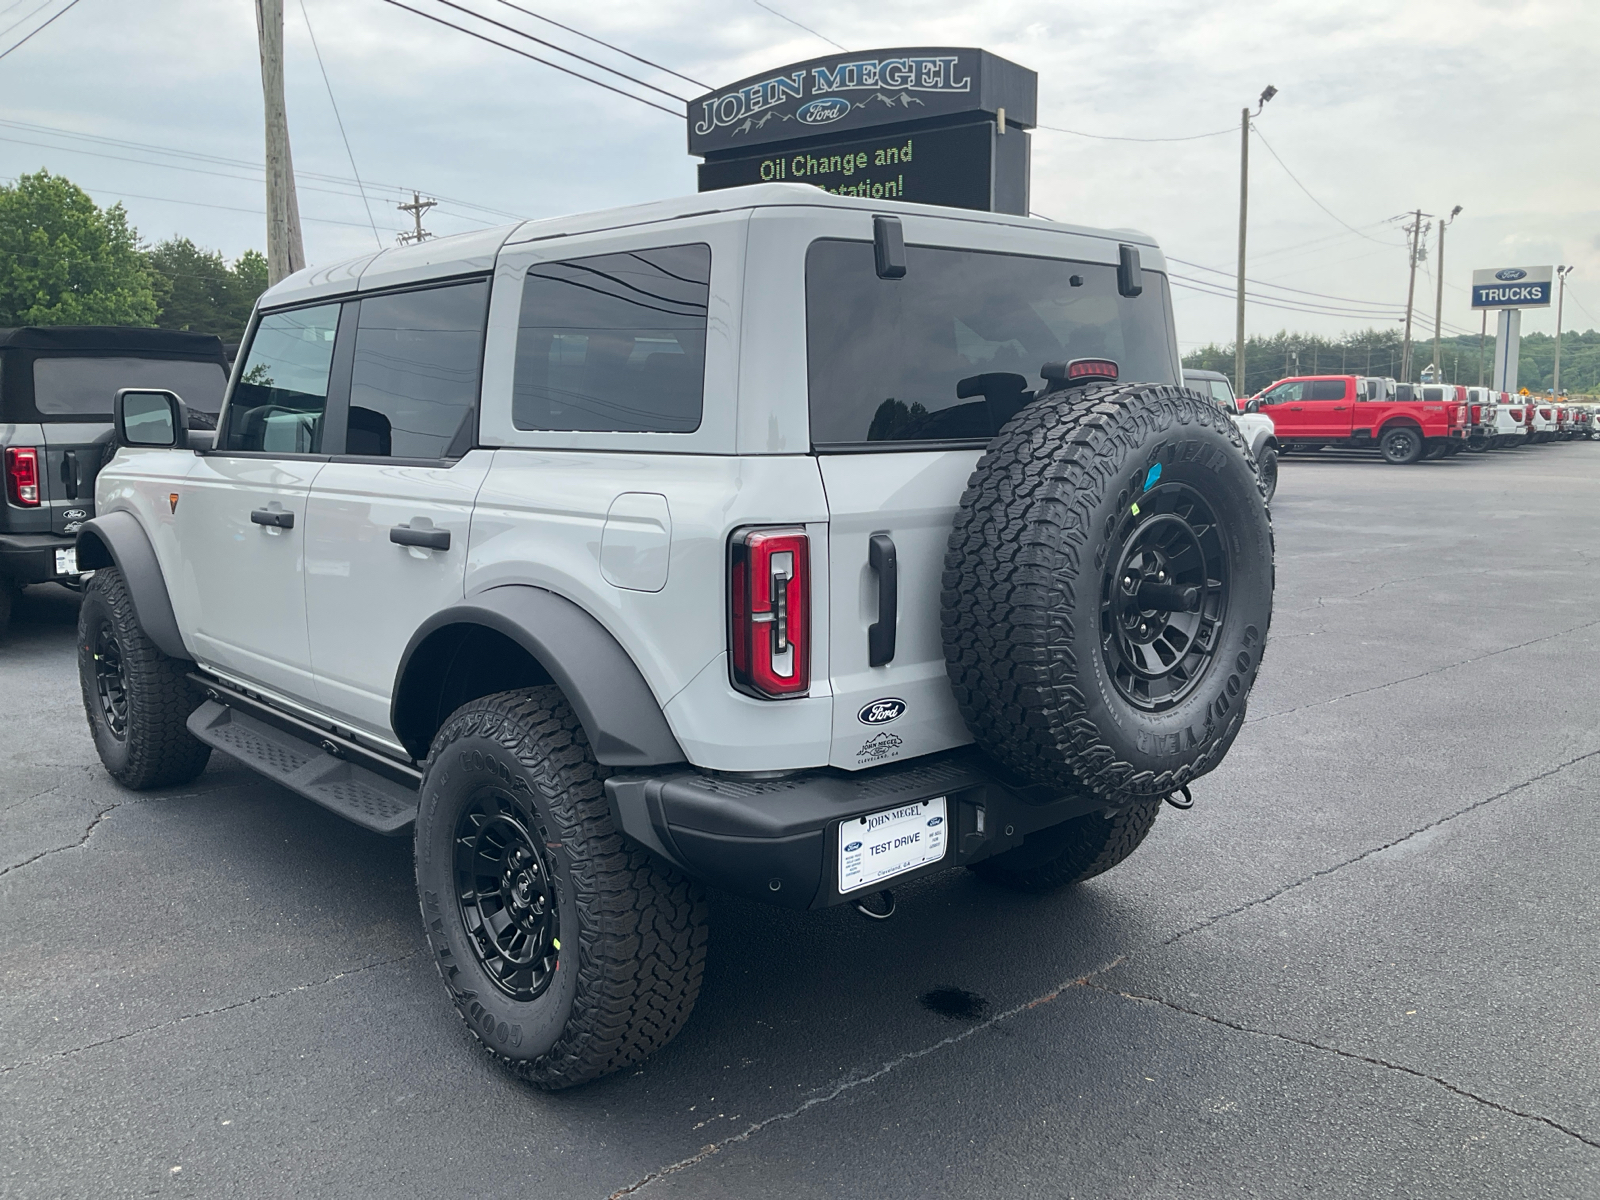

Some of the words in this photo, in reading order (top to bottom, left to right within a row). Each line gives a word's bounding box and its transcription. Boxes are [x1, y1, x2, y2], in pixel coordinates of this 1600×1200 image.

[695, 71, 806, 135] JOHN
[811, 56, 971, 93] MEGEL
[806, 101, 841, 122] Ford
[760, 158, 786, 181] Oil
[791, 152, 868, 176] Change
[874, 139, 913, 166] and
[1479, 286, 1542, 302] TRUCKS
[868, 702, 899, 722] Ford
[861, 742, 877, 753] JOHN
[877, 738, 898, 747] MEGEL
[866, 813, 891, 832] JOHN
[891, 805, 922, 821] MEGEL
[869, 840, 892, 857] TEST
[894, 831, 921, 849] DRIVE
[903, 861, 911, 869] GA
